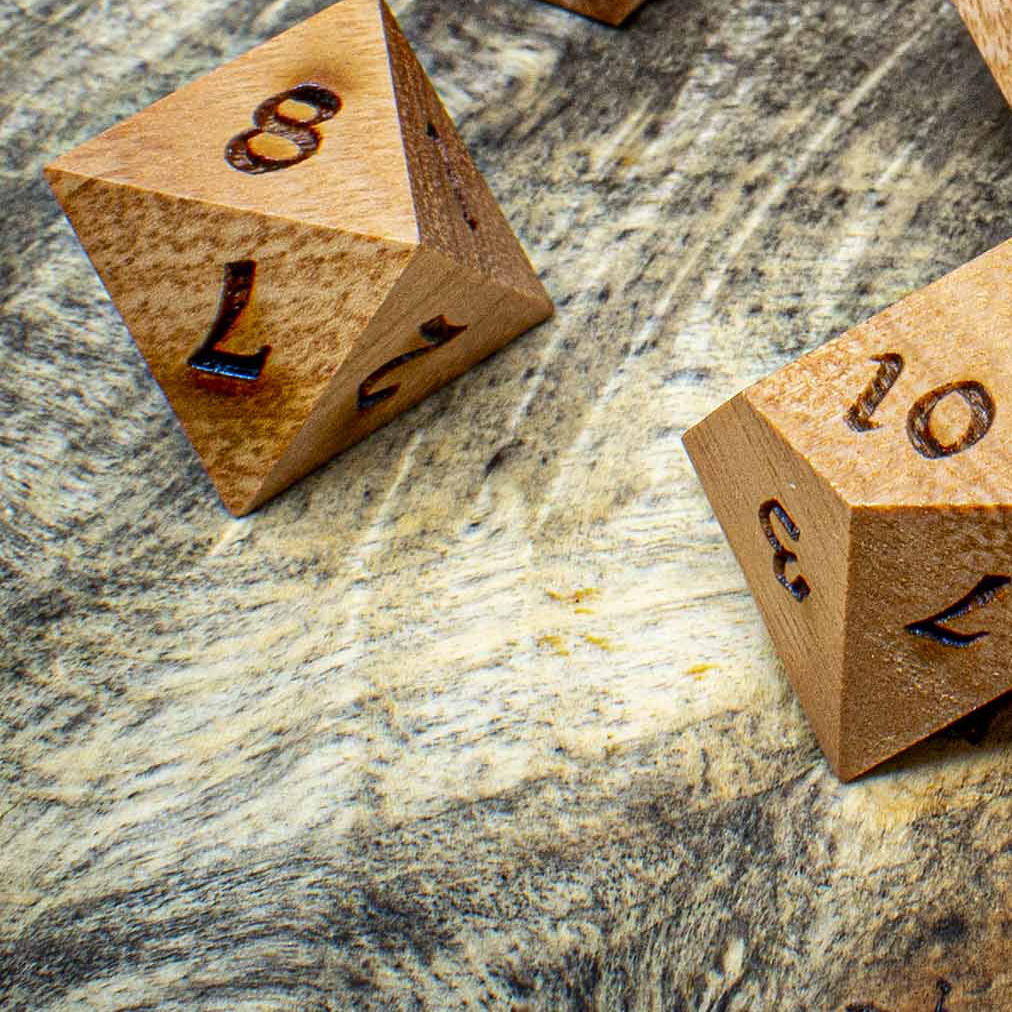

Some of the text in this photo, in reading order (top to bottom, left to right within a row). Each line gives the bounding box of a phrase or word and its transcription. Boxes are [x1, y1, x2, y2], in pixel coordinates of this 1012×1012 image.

[224, 83, 343, 175] 8
[188, 259, 272, 381] 7
[844, 352, 997, 460] 10
[758, 497, 812, 603] 3
